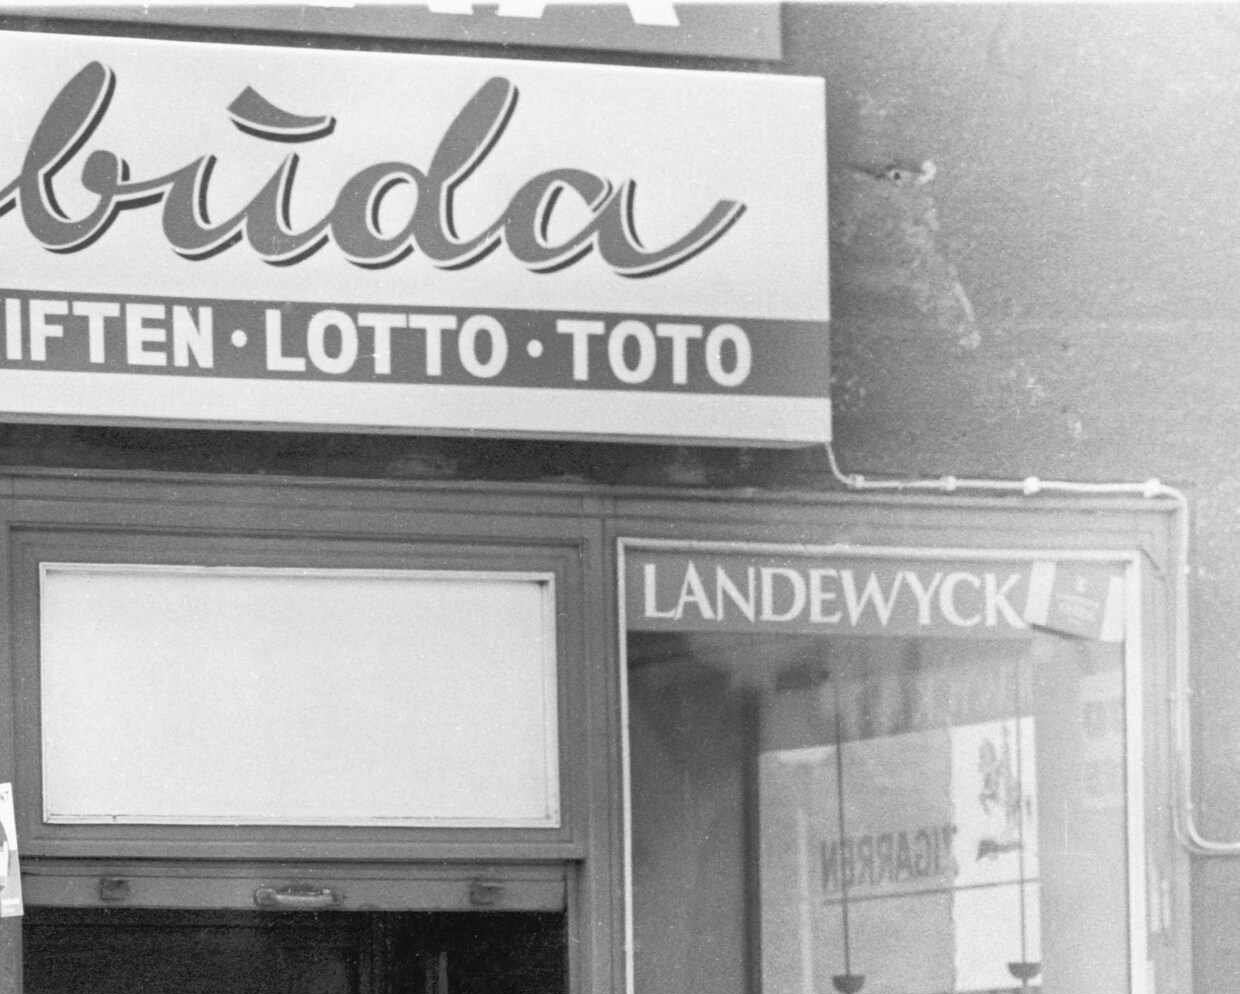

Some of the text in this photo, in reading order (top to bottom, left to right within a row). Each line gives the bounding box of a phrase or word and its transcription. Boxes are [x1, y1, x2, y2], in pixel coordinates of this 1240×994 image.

[264, 309, 508, 379] LOTTO
[556, 318, 752, 388] TOTO
[643, 561, 1030, 629] LANDEWYCK
